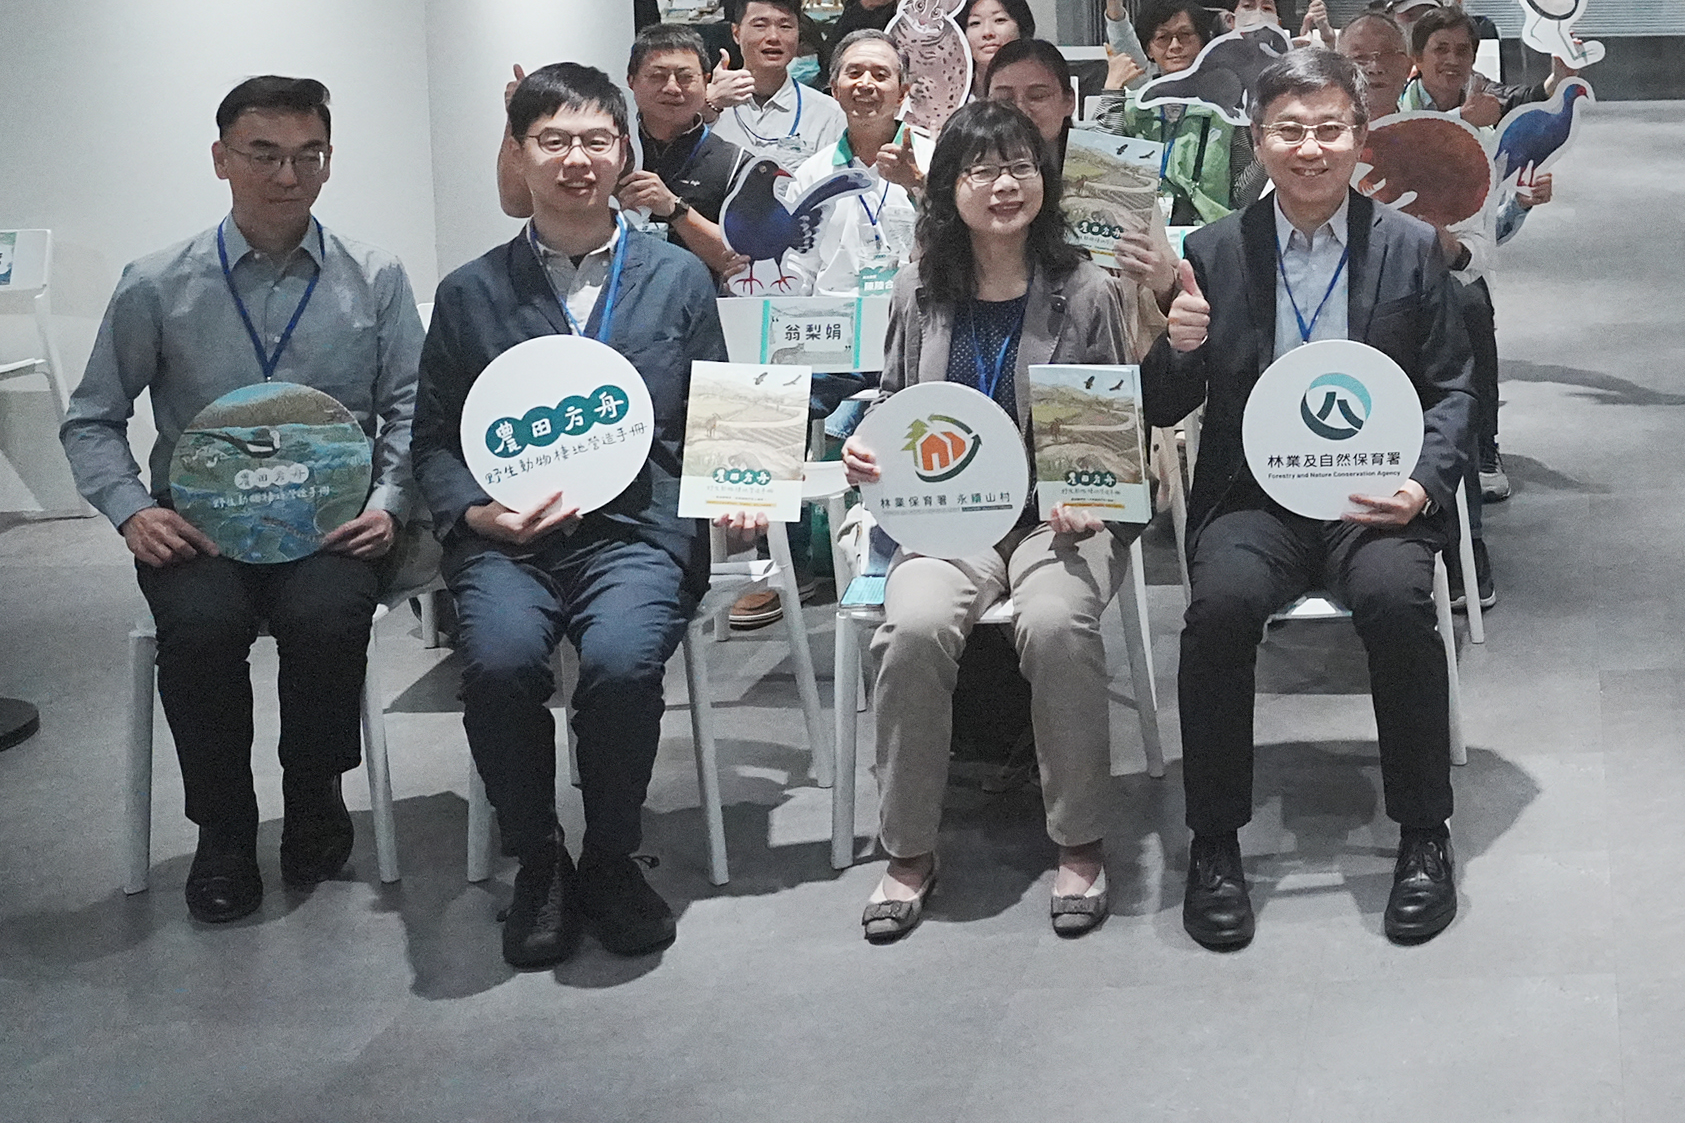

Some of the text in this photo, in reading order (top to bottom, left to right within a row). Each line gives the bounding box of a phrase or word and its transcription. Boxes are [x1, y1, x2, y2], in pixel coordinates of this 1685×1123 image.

[785, 323, 841, 341] 翁梨娟
[494, 391, 625, 454] 農田方舟
[1267, 451, 1401, 468] 林業及自然保育署
[880, 494, 947, 509] 林業保育署
[957, 492, 1010, 505] 永續山村
